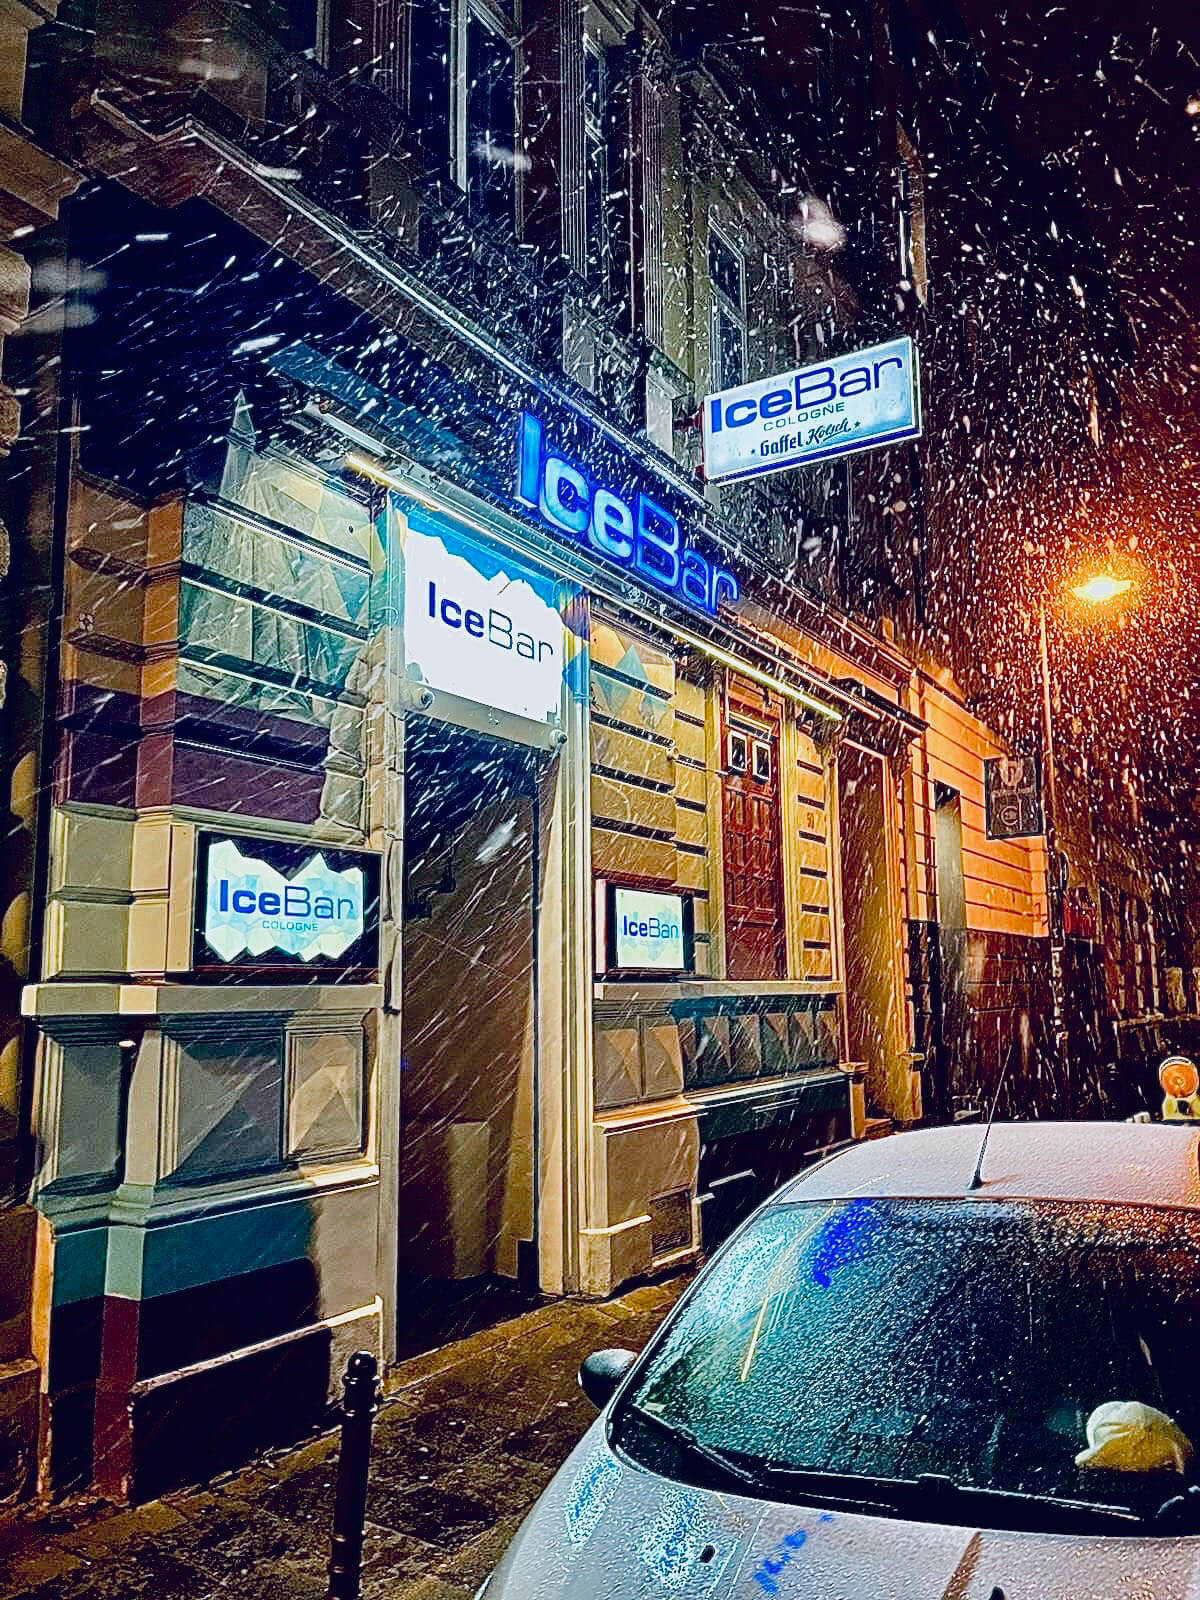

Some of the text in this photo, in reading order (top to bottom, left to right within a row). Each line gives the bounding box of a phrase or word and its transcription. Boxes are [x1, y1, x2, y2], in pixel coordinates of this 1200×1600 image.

[710, 357, 903, 434] IceBar
[763, 402, 845, 432] COLOGNE
[760, 431, 803, 457] Gaffel
[514, 410, 739, 616] IceBar
[428, 581, 554, 663] IceBar
[219, 879, 354, 920] IceBar
[263, 920, 319, 932] COLOGNE
[623, 915, 679, 939] IceBar
